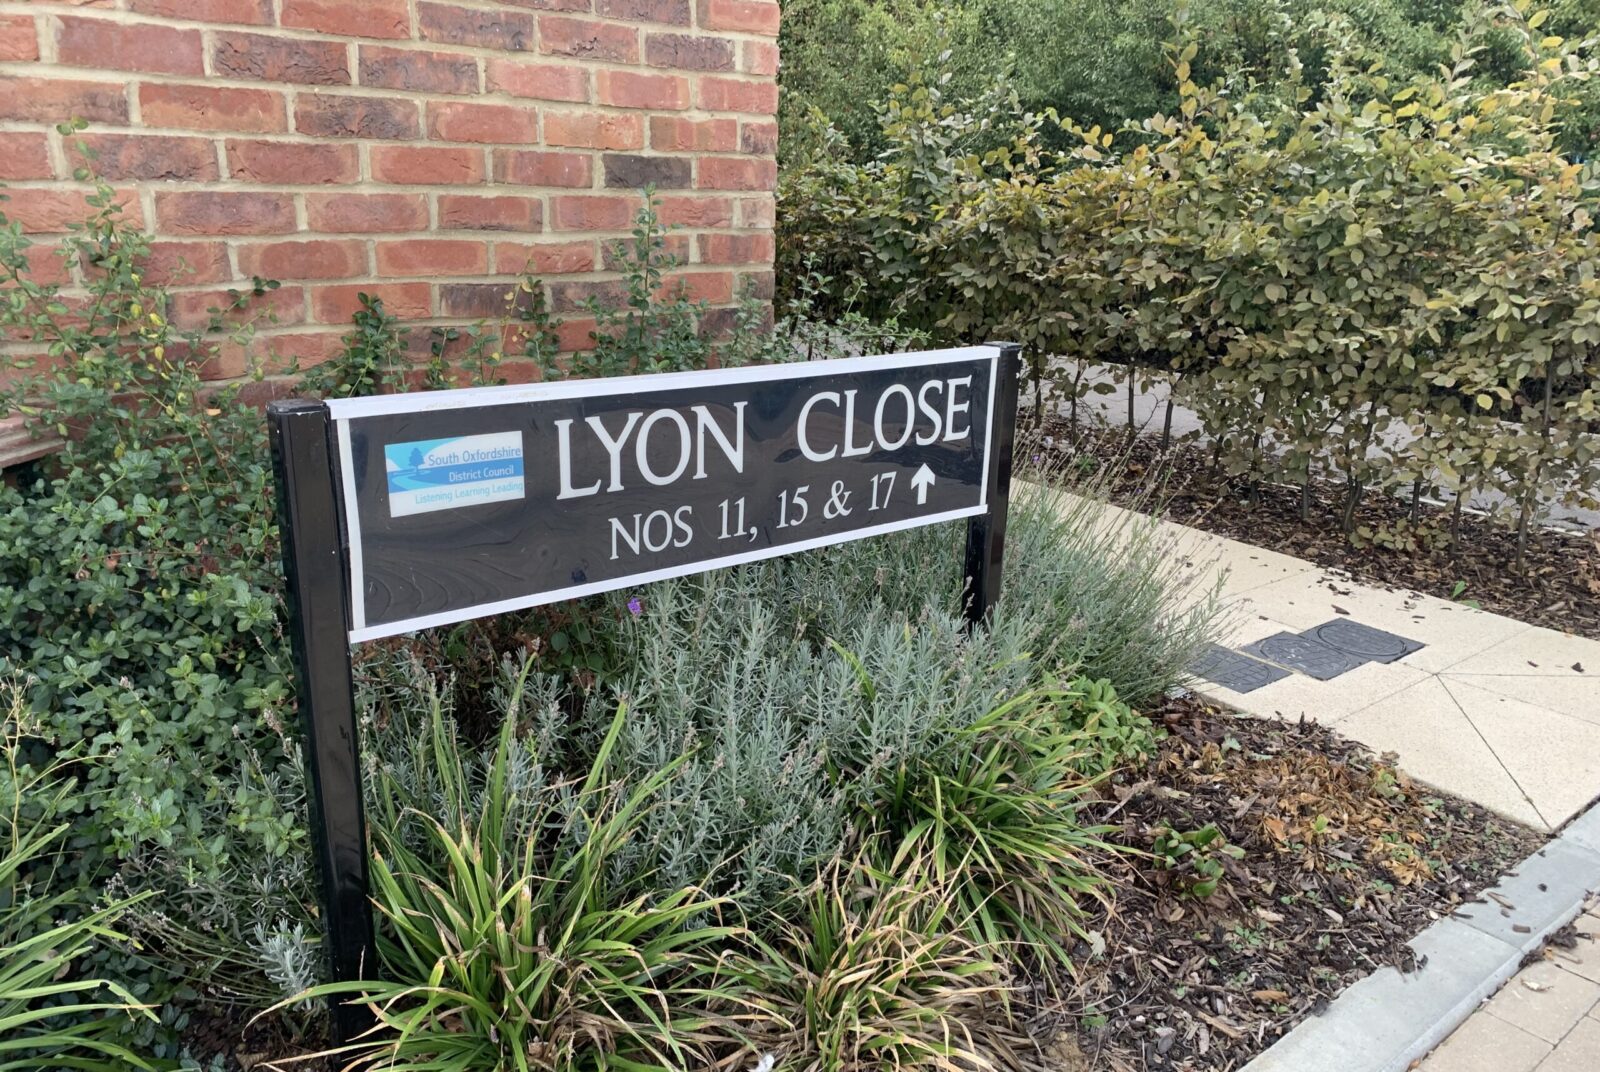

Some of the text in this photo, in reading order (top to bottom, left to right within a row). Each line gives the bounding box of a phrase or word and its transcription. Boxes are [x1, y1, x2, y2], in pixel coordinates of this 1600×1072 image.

[554, 375, 972, 500] LYON CLOSE
[428, 446, 521, 466] South Oxfordshire
[449, 465, 514, 482] District Council
[415, 481, 523, 505] Listening Learning Leading
[609, 471, 897, 560] NOS 11, 15 & 17
